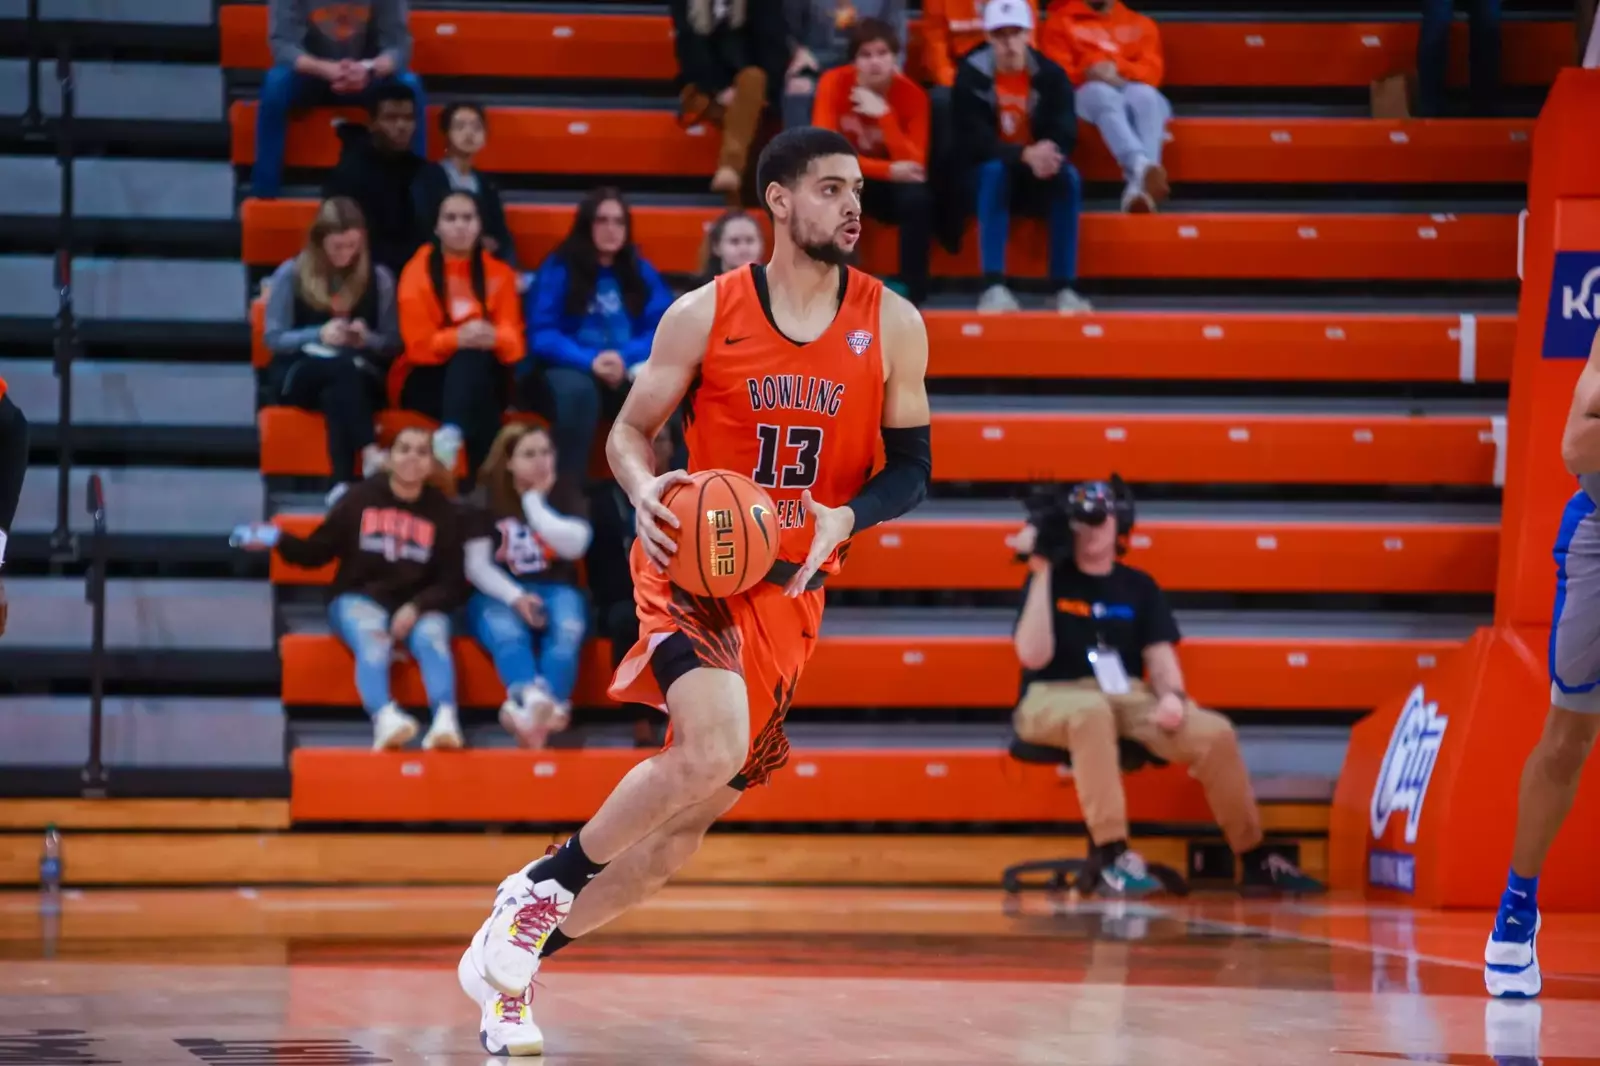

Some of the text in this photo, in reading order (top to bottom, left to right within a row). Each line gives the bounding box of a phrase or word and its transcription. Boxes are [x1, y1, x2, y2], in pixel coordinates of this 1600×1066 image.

[747, 375, 845, 417] BOWLING
[752, 424, 823, 489] 13
[777, 499, 806, 530] EEN
[714, 508, 736, 577] ELITE
